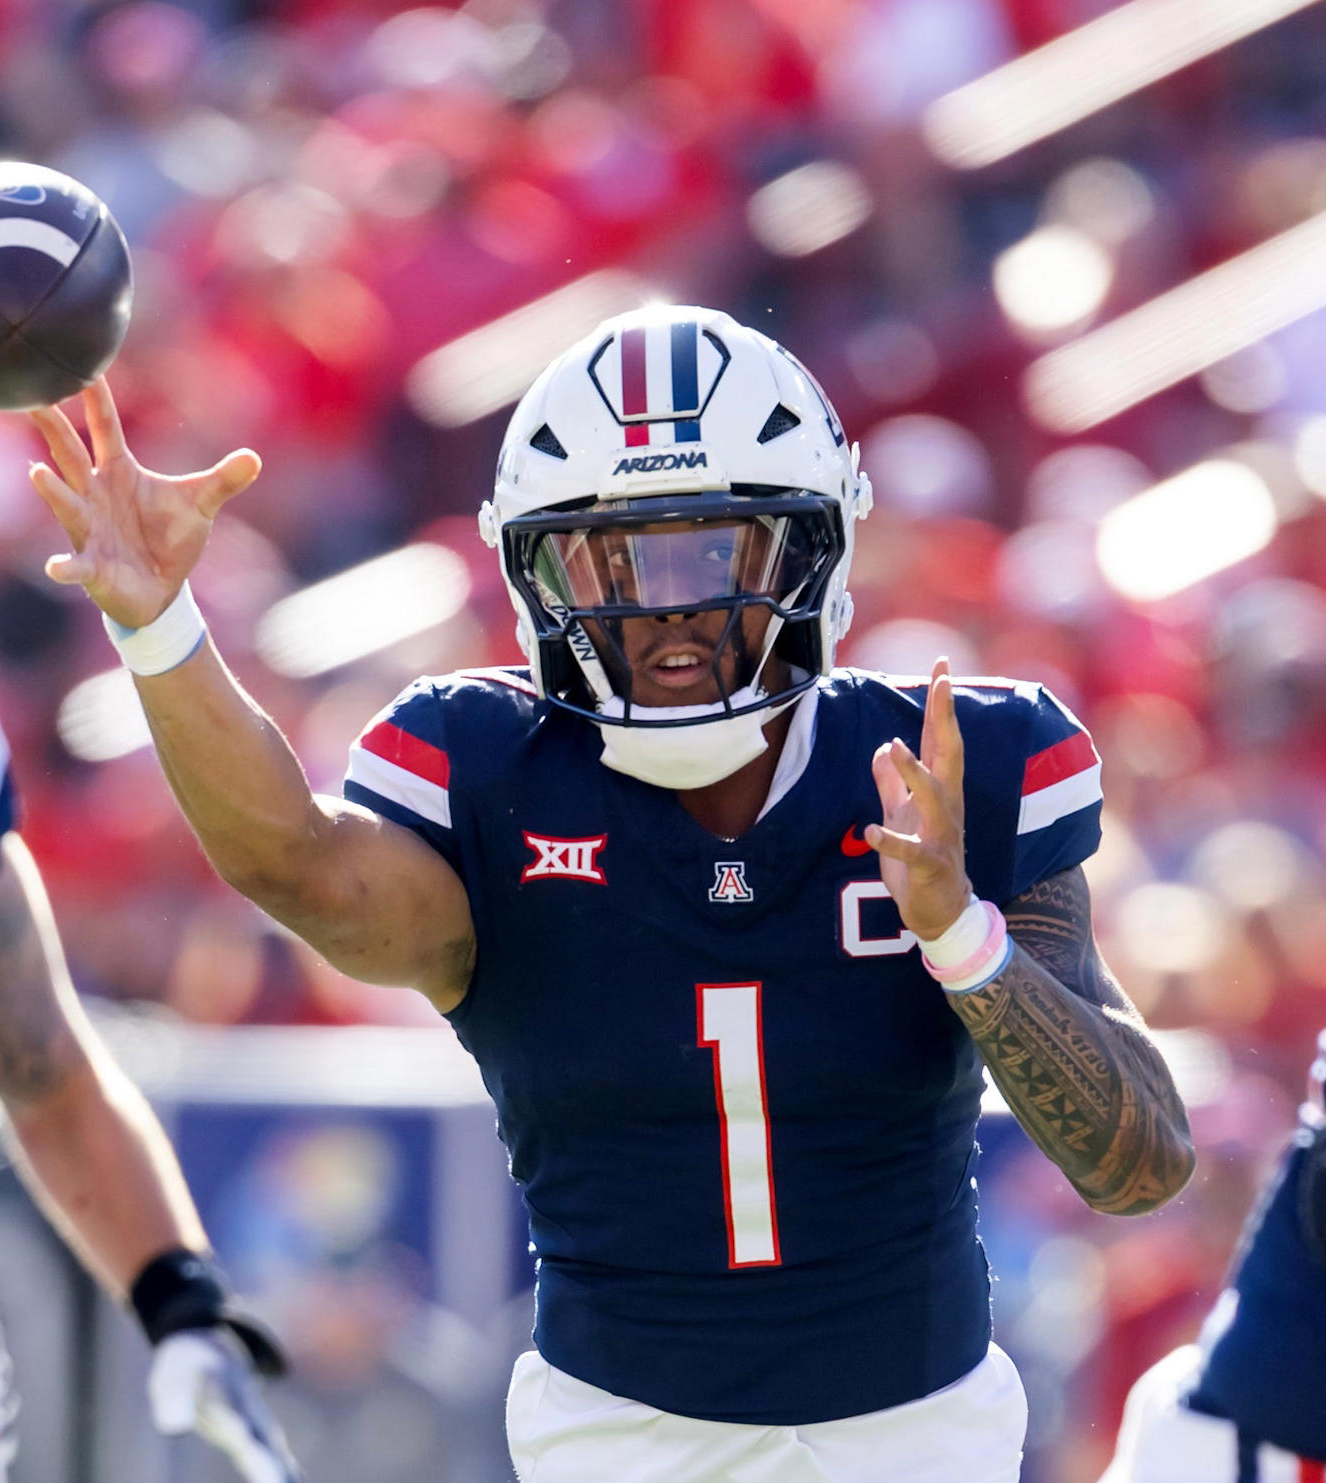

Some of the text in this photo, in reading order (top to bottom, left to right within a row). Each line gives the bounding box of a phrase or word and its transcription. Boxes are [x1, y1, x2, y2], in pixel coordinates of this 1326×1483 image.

[611, 451, 708, 475] ARIZONA
[523, 832, 606, 883] XII
[708, 861, 754, 903] A
[840, 880, 918, 957] C
[695, 981, 781, 1269] 1
